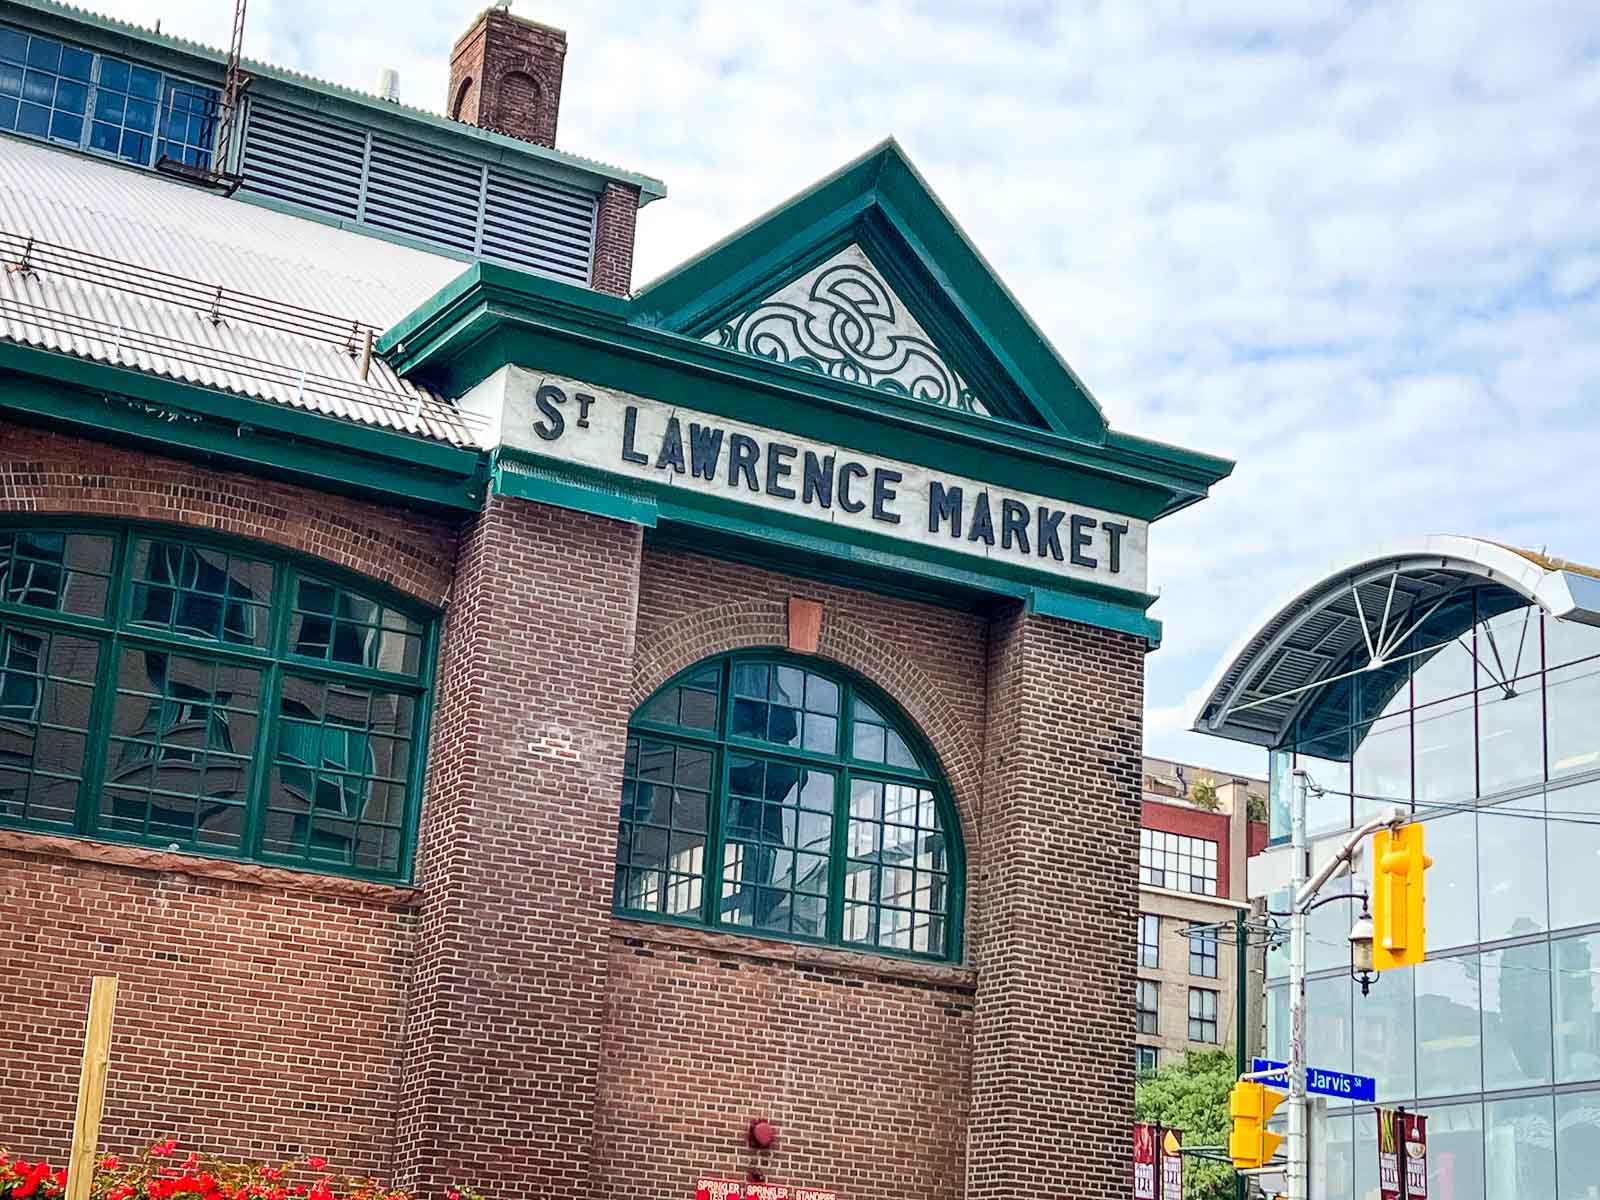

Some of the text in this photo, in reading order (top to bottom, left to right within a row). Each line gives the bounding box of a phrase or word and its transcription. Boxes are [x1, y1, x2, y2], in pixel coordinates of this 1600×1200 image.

[622, 406, 903, 524] LAWRENCE
[928, 481, 1129, 574] MARKET
[1311, 1070, 1351, 1093] Jarvis
[697, 1180, 740, 1195] SPRINKLER
[747, 1185, 788, 1200] SPRINKLER
